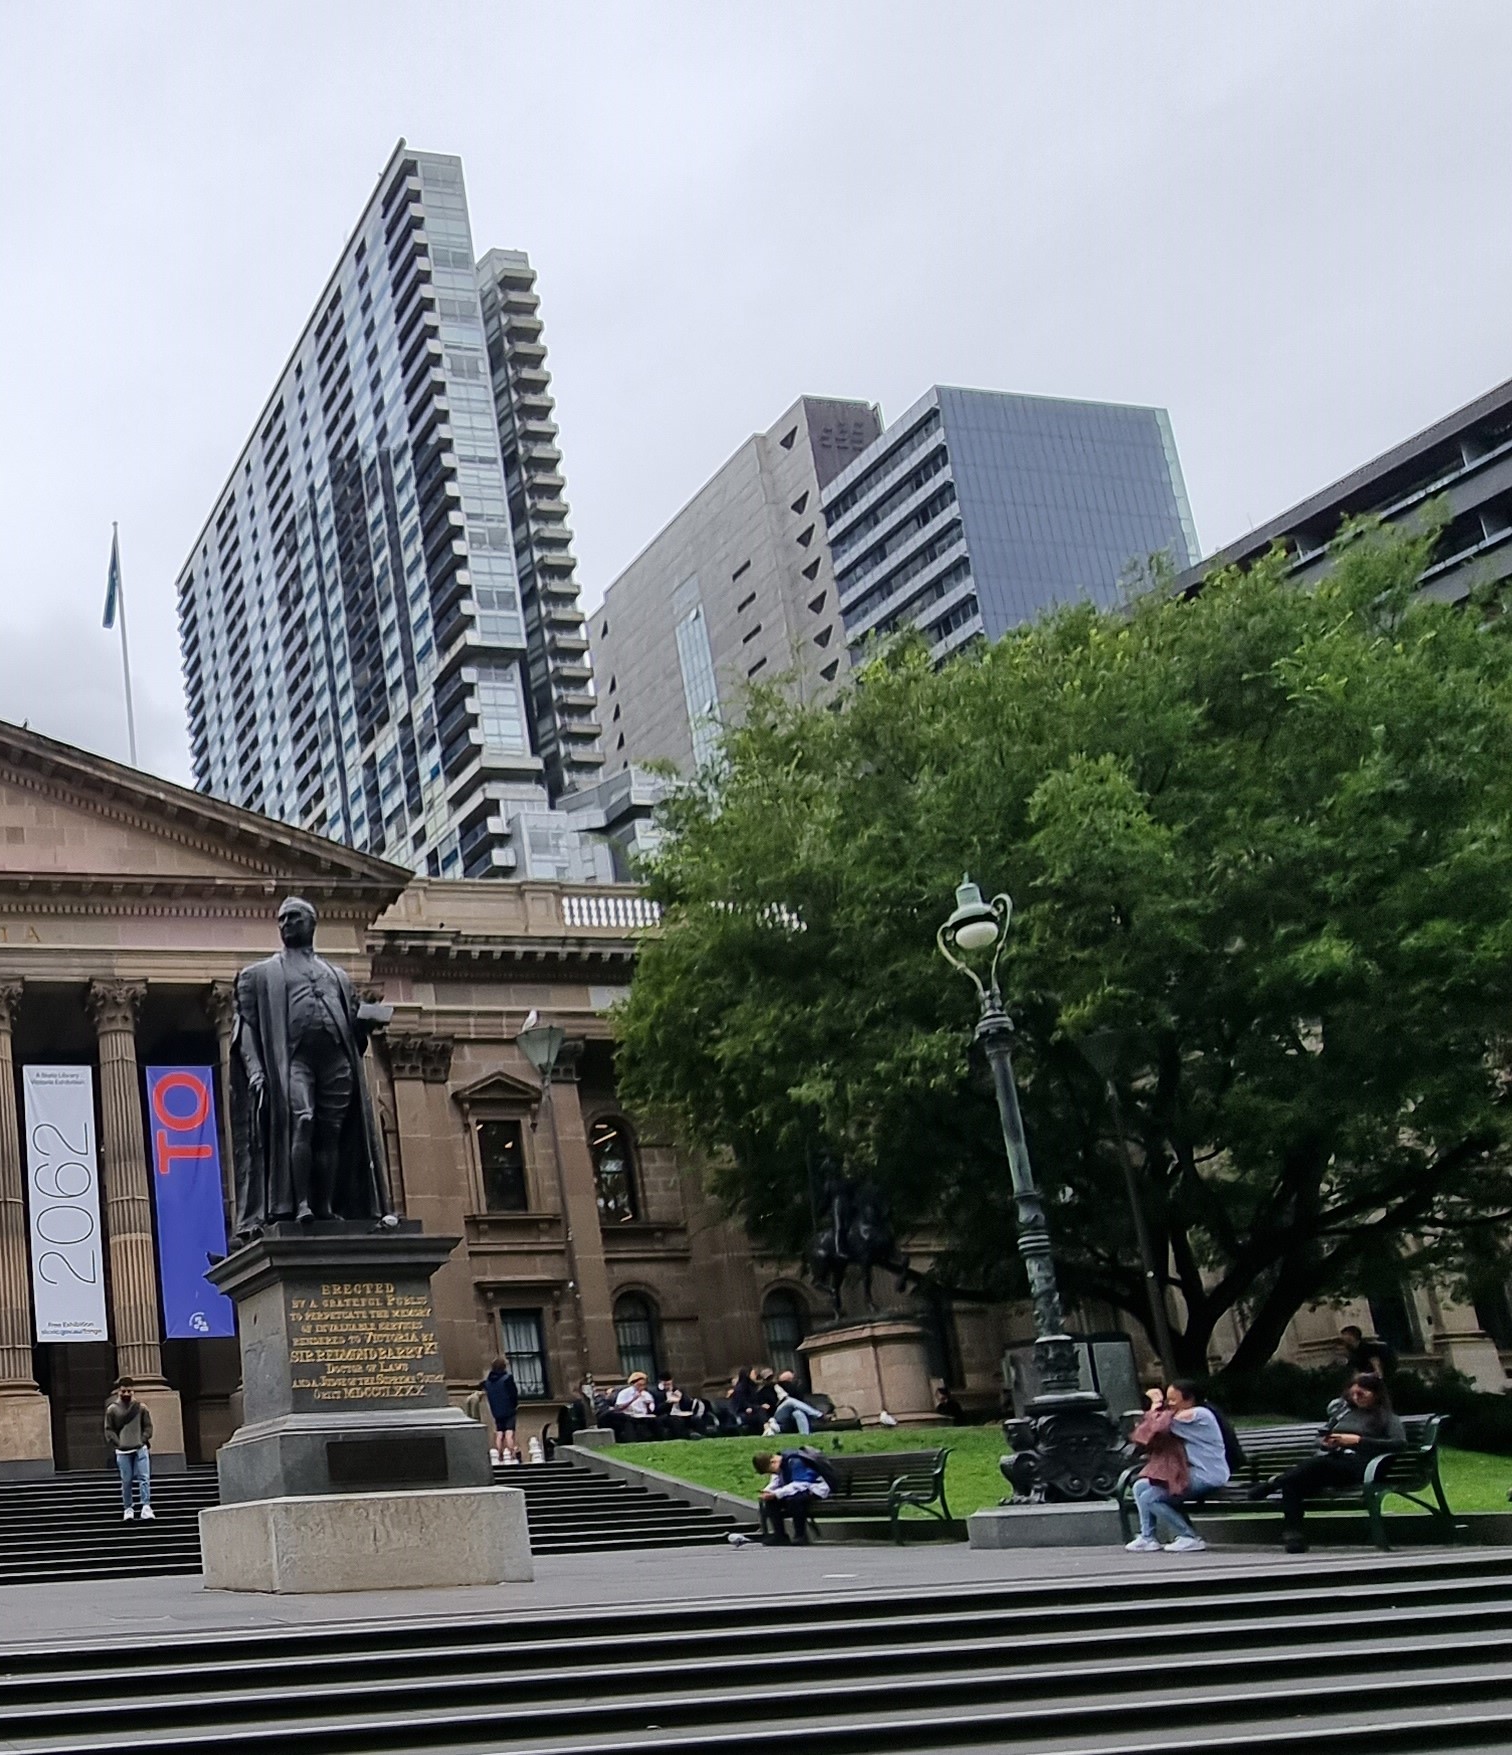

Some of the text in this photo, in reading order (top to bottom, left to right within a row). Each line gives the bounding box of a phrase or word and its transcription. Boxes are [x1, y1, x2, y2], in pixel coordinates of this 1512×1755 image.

[153, 1072, 213, 1175] TO
[32, 1121, 96, 1285] 2062
[321, 1283, 395, 1296] ERECTED
